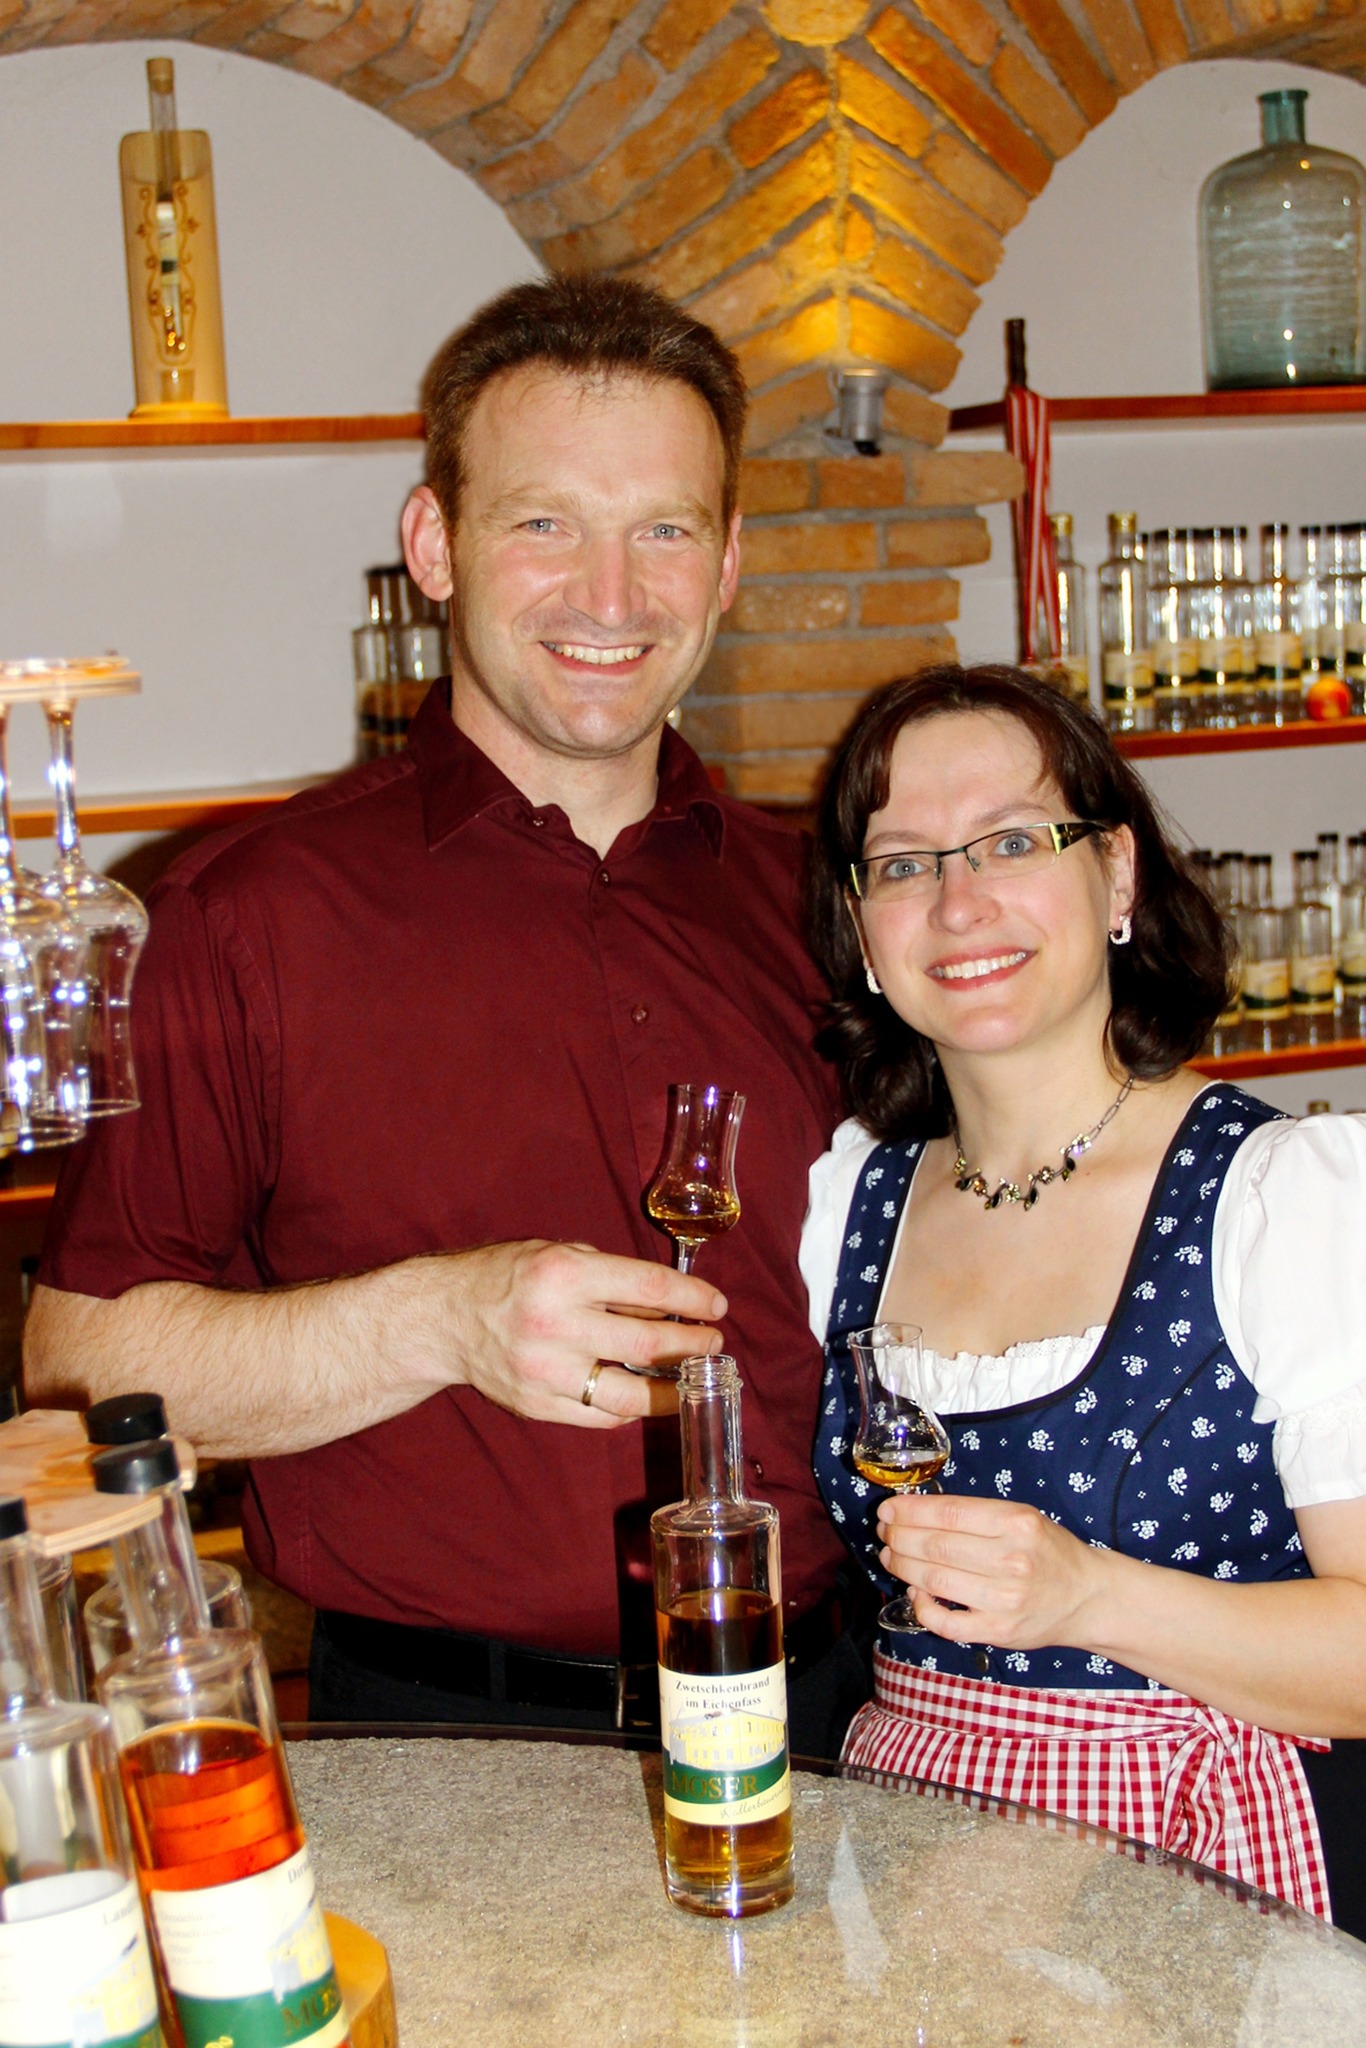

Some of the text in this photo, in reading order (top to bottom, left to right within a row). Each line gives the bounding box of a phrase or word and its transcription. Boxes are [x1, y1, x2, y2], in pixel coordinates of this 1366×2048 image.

[675, 1676, 770, 1694] Zwetschkenbrand
[685, 1696, 762, 1710] im Eichenfass
[671, 1771, 759, 1800] MOSER
